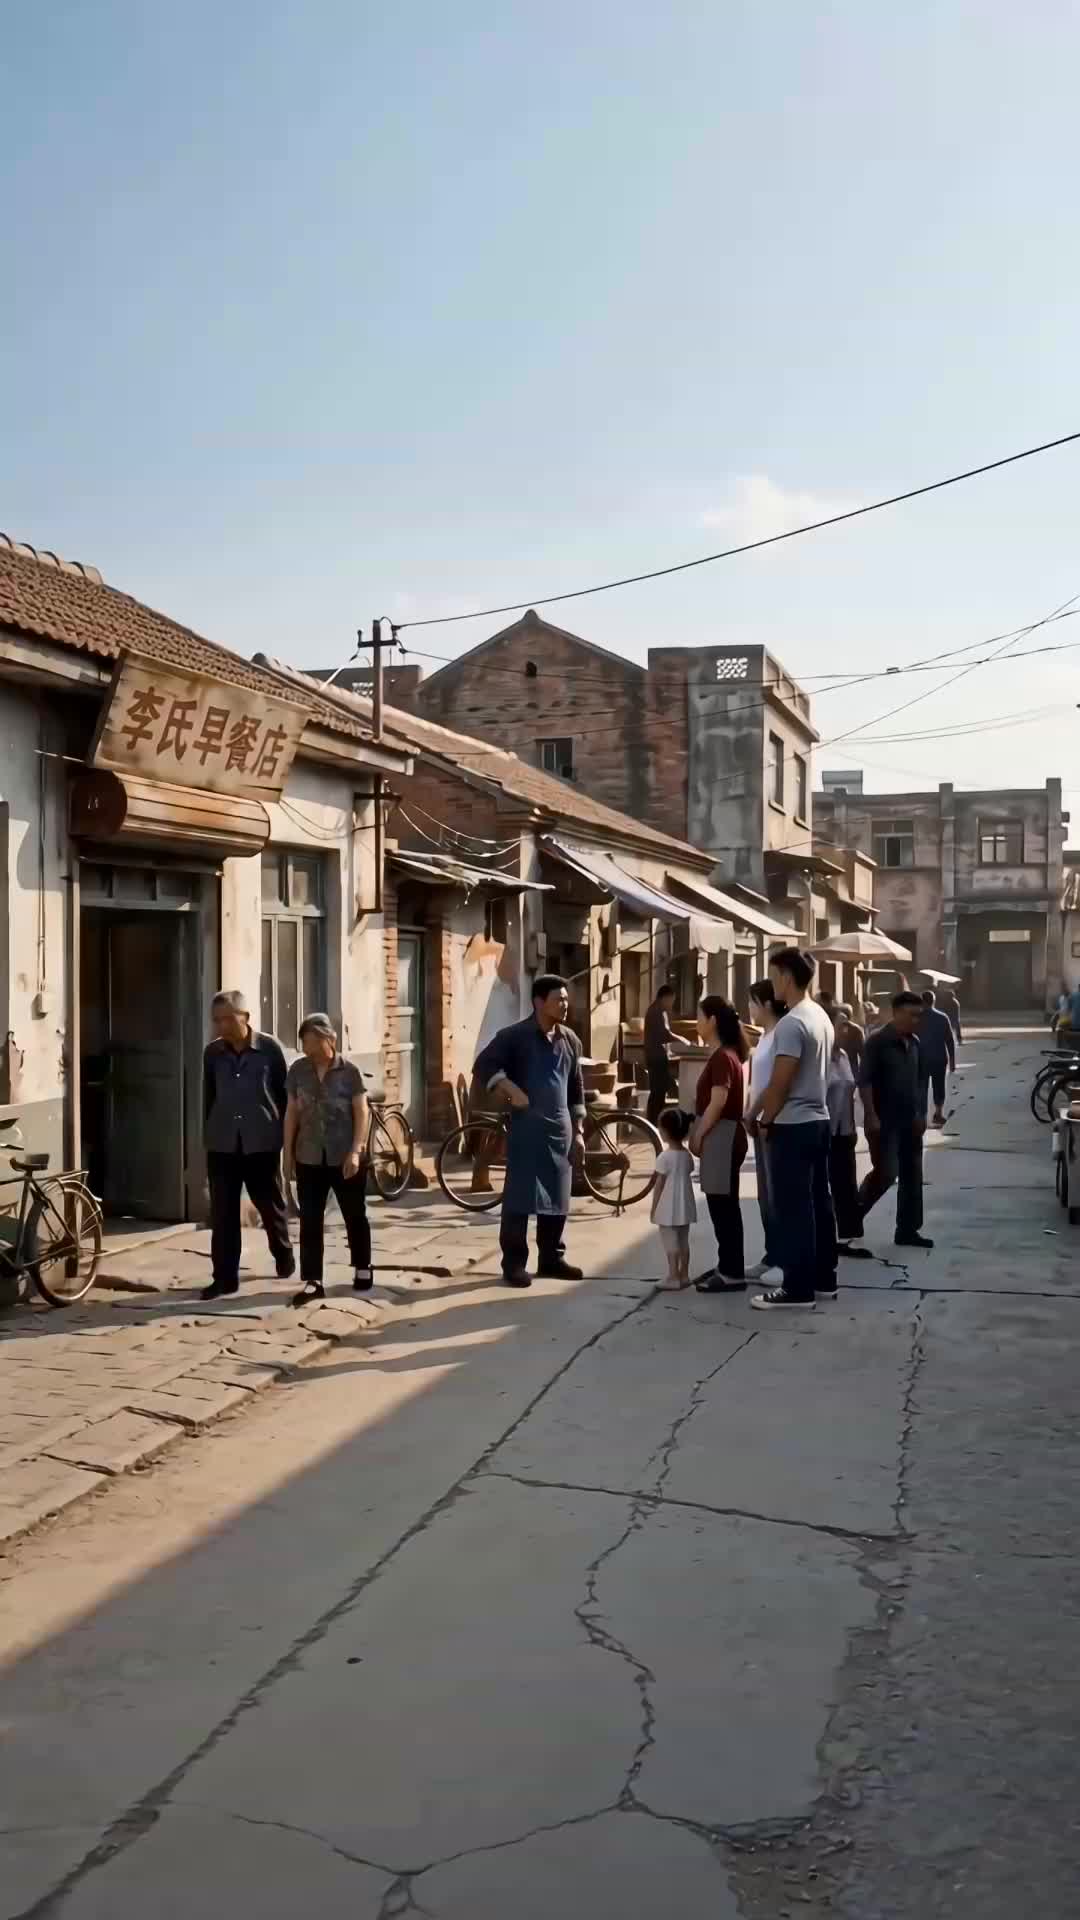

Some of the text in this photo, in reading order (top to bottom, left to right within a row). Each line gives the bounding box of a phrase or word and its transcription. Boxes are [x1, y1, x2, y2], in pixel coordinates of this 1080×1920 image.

[120, 686, 288, 778] 李氏早餐店
